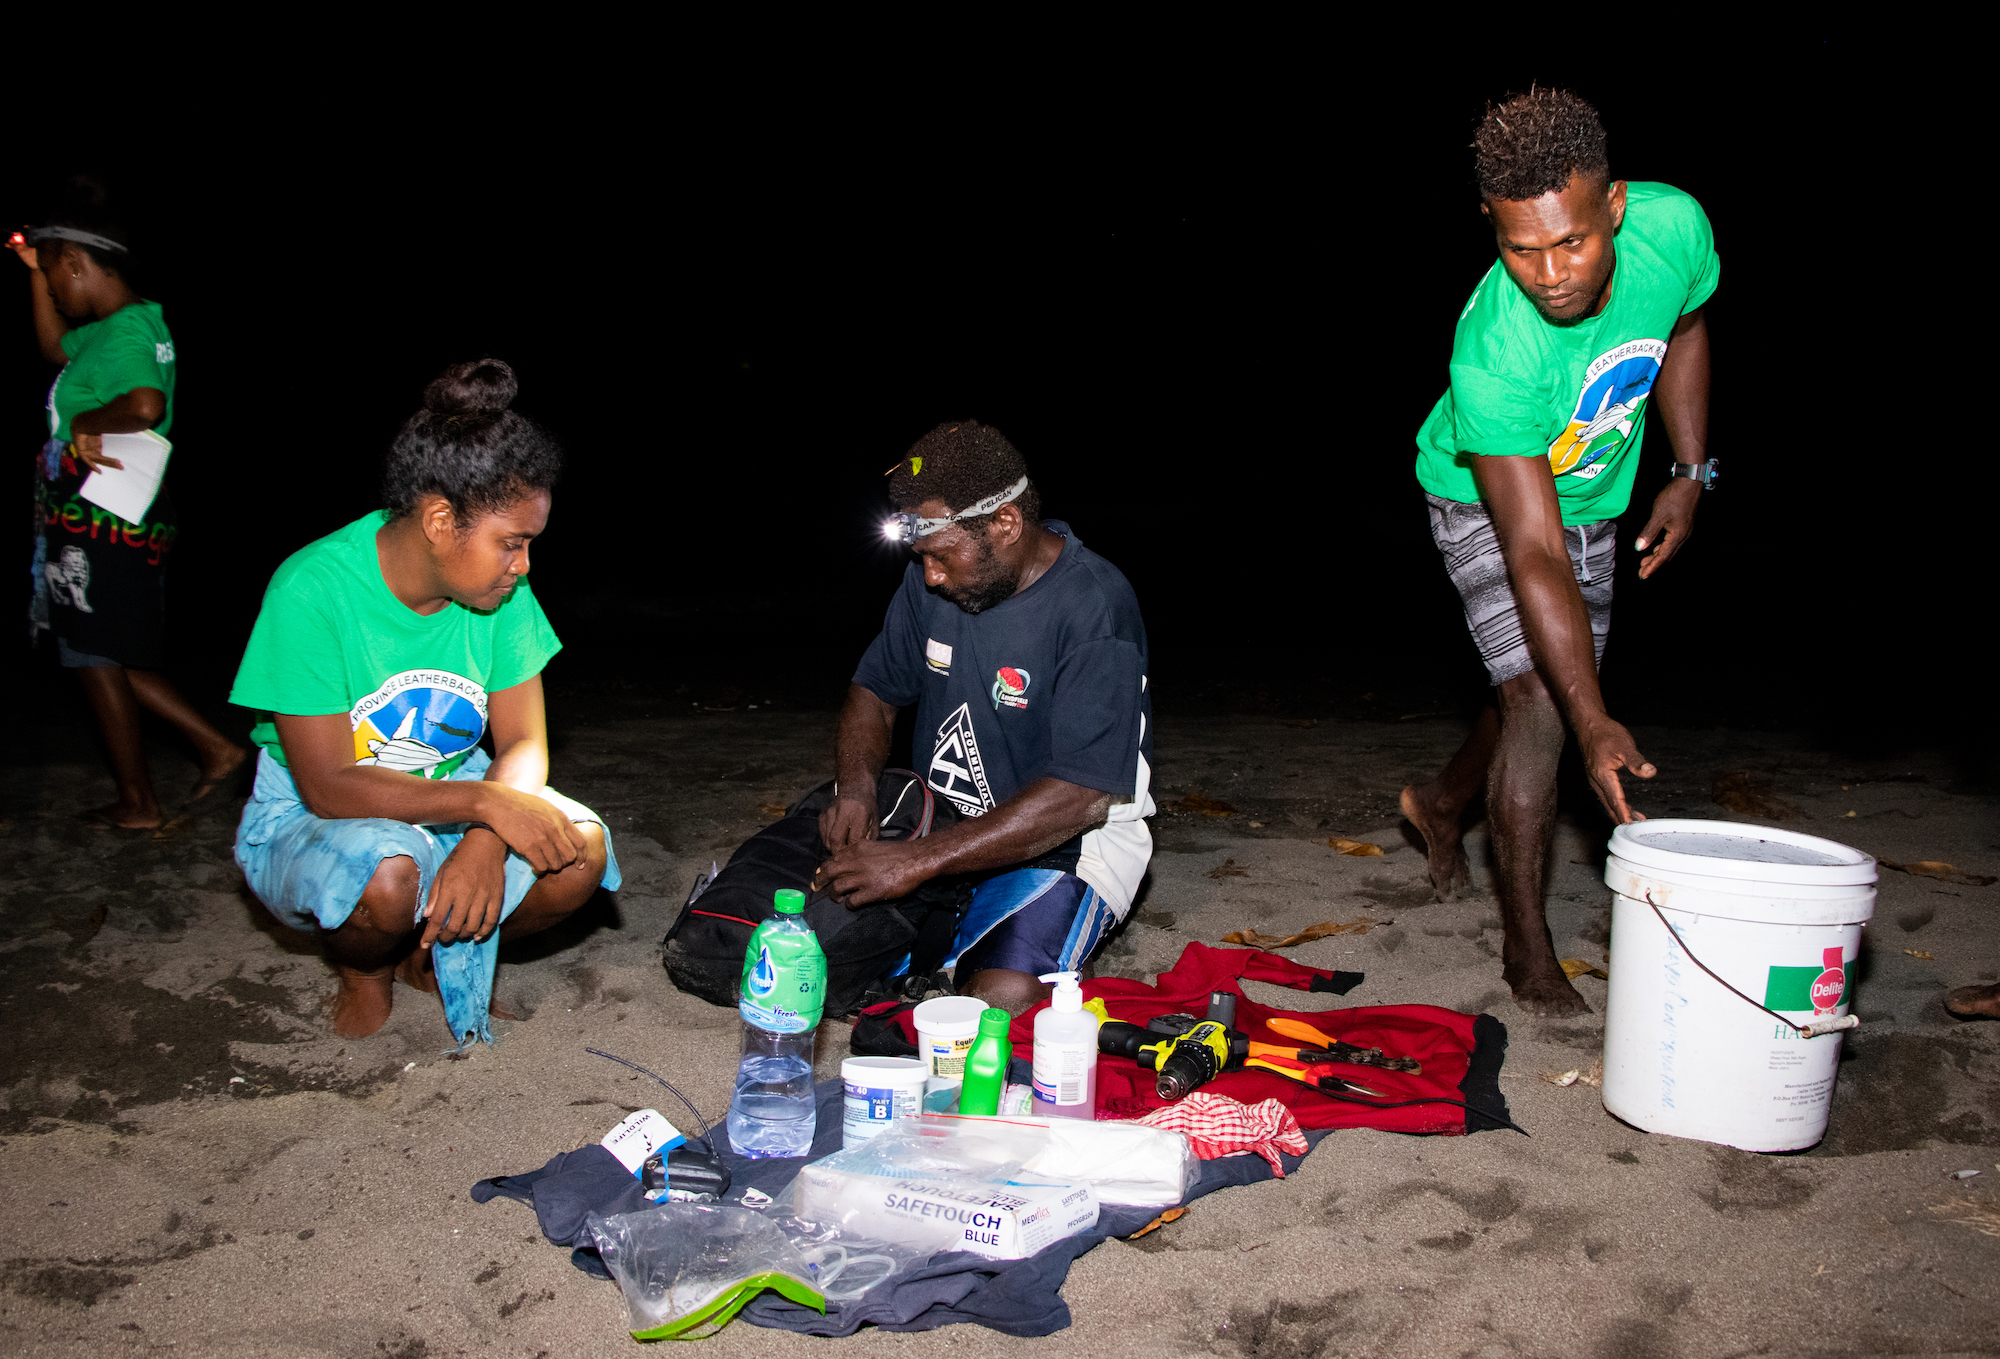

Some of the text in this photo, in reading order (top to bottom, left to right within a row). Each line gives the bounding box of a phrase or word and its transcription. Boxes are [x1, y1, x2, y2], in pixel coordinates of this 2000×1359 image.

[1591, 344, 1655, 376] LEATHERBACK
[981, 489, 1012, 511] PELICAN
[353, 681, 397, 722] PROVINCE
[398, 673, 479, 699] LEATHERBACK
[964, 731, 991, 806] COMMERCIAL
[1813, 981, 1844, 997] Delite
[1773, 1024, 1803, 1040] HA
[857, 1086, 868, 1096] 40
[875, 1105, 888, 1119] B
[611, 1114, 651, 1146] WILDLIFE
[1061, 1188, 1087, 1206] SAFETOUCH
[884, 1193, 1001, 1230] SAFETOUCH
[965, 1229, 1000, 1247] BLUE
